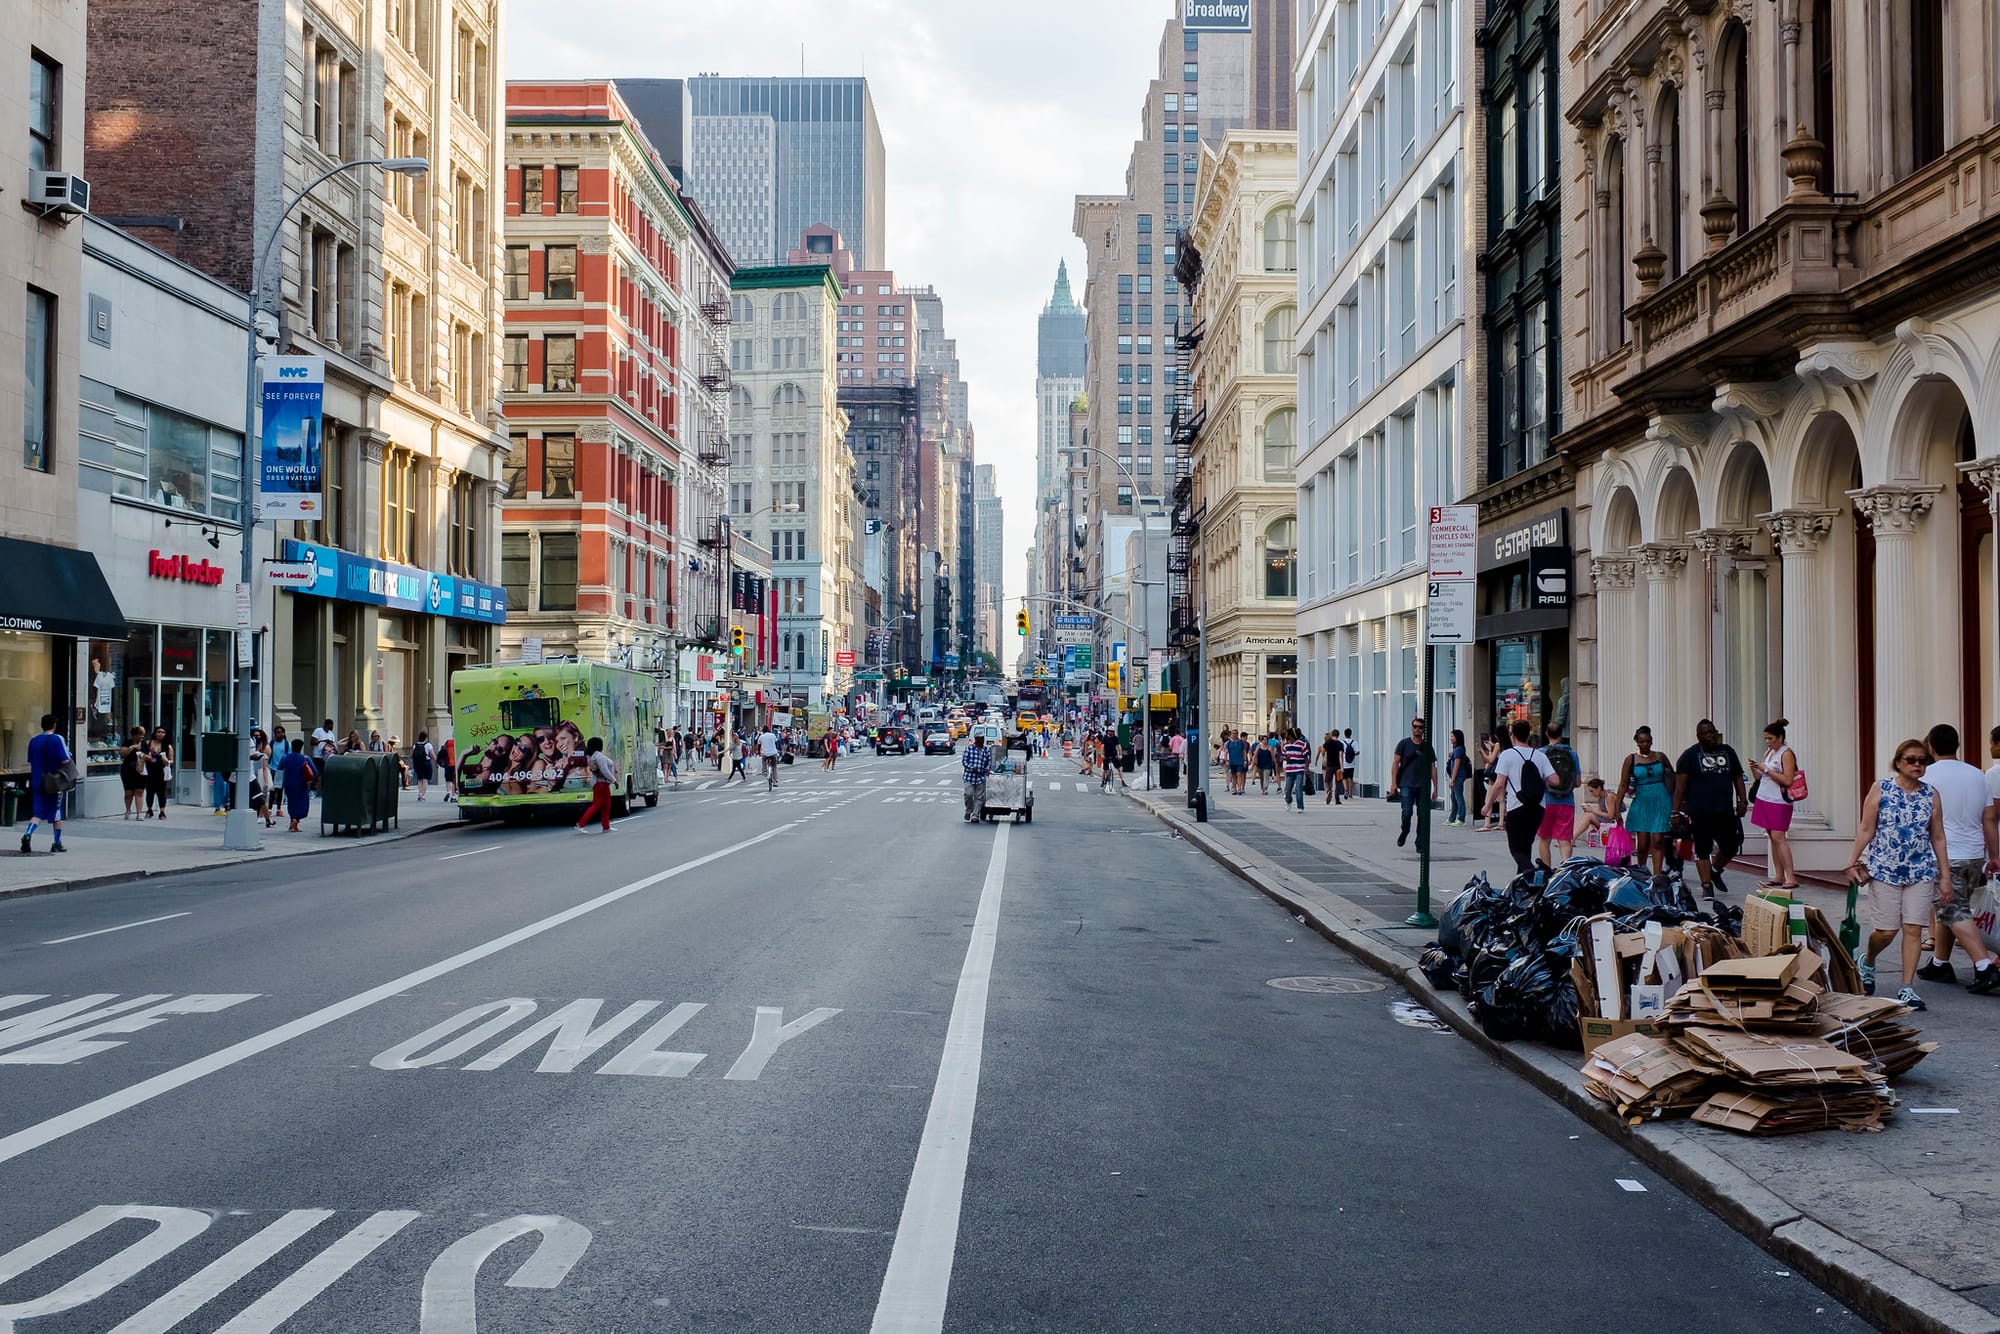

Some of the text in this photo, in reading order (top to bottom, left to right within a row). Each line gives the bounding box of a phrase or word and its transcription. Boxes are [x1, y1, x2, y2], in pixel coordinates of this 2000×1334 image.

[1186, 0, 1248, 22] Broadway
[280, 368, 308, 378] NYC
[266, 392, 320, 400] SEE FOREVER
[285, 465, 316, 473] WORLD
[1432, 508, 1440, 521] 3
[1460, 532, 1474, 540] ONLY
[1495, 518, 1558, 560] G-STAR RAW
[149, 550, 224, 584] Foot Locker
[1430, 583, 1438, 596] 2
[1539, 596, 1566, 604] RAW
[1246, 636, 1284, 644] American
[370, 997, 844, 1081] ONLY
